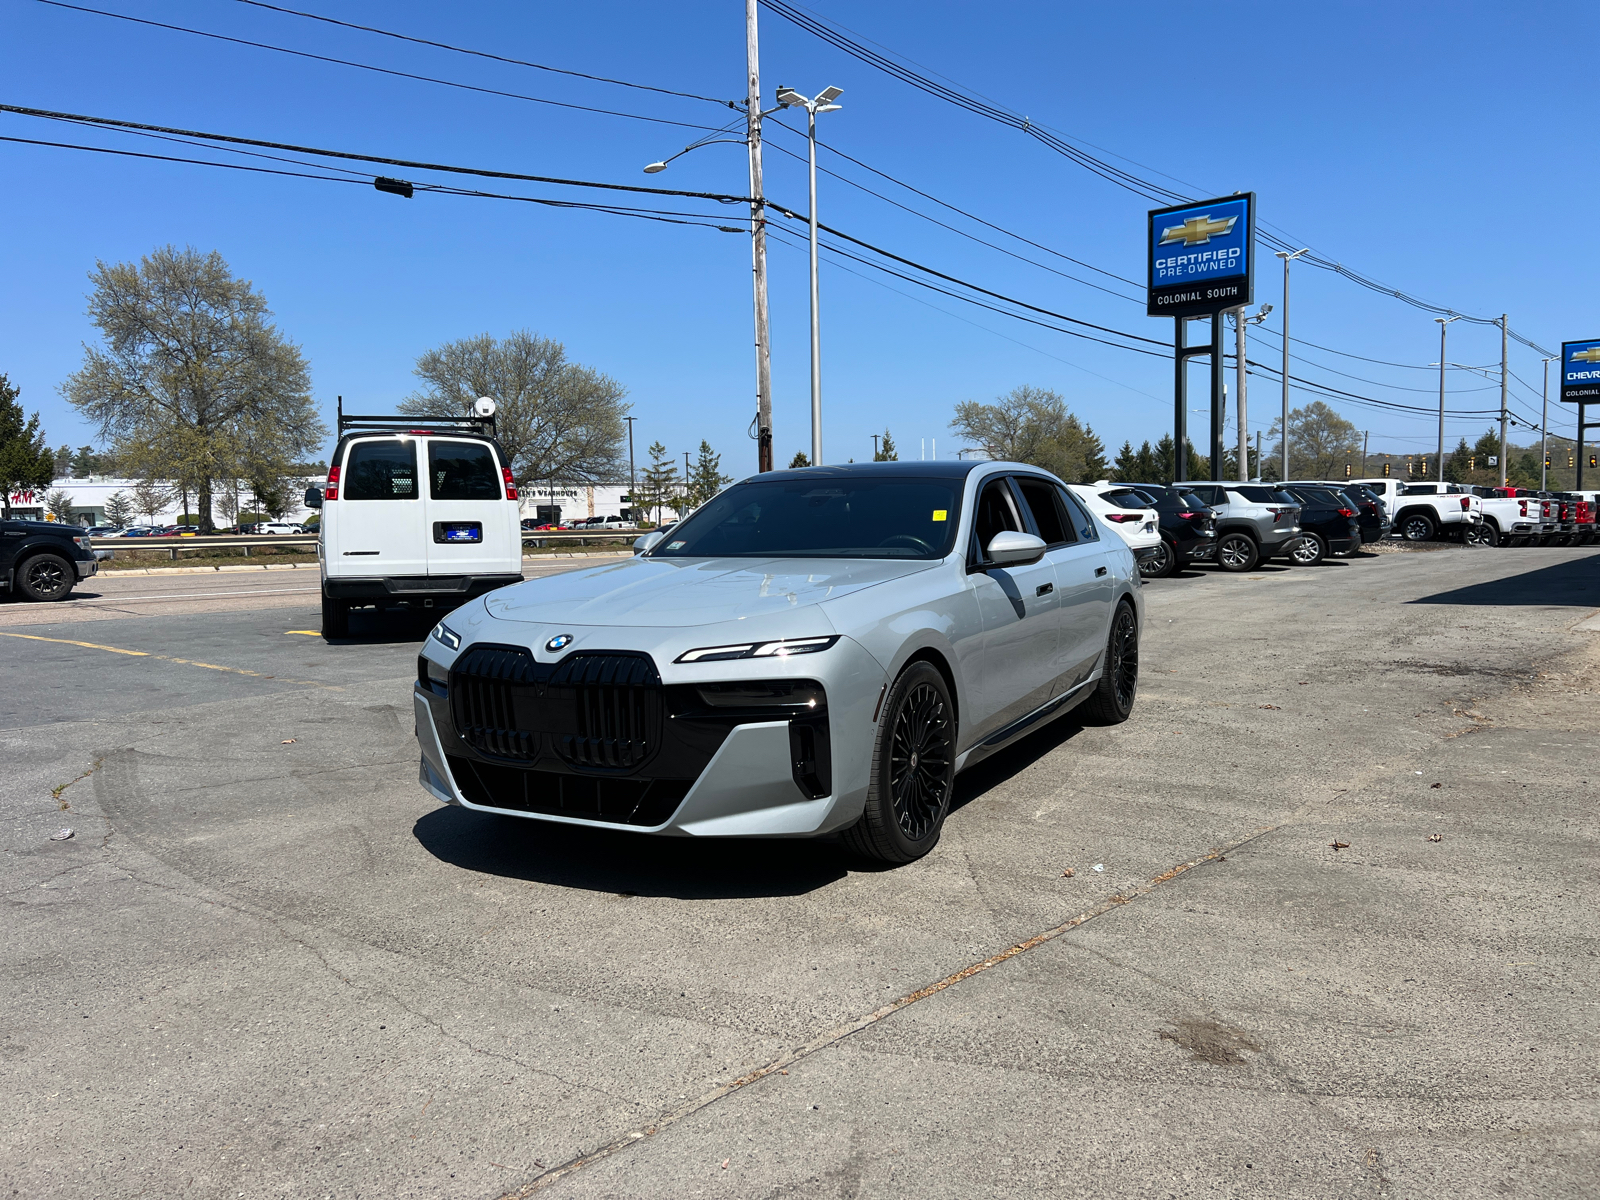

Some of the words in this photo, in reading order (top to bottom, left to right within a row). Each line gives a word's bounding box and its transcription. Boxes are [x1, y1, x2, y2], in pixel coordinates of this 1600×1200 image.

[1155, 247, 1241, 269] CERTIFIED
[1159, 258, 1236, 278] PRE-OWNED
[1157, 291, 1202, 305] COLONIAL
[1207, 286, 1238, 299] SOUTH
[1565, 389, 1600, 397] COLONIAL
